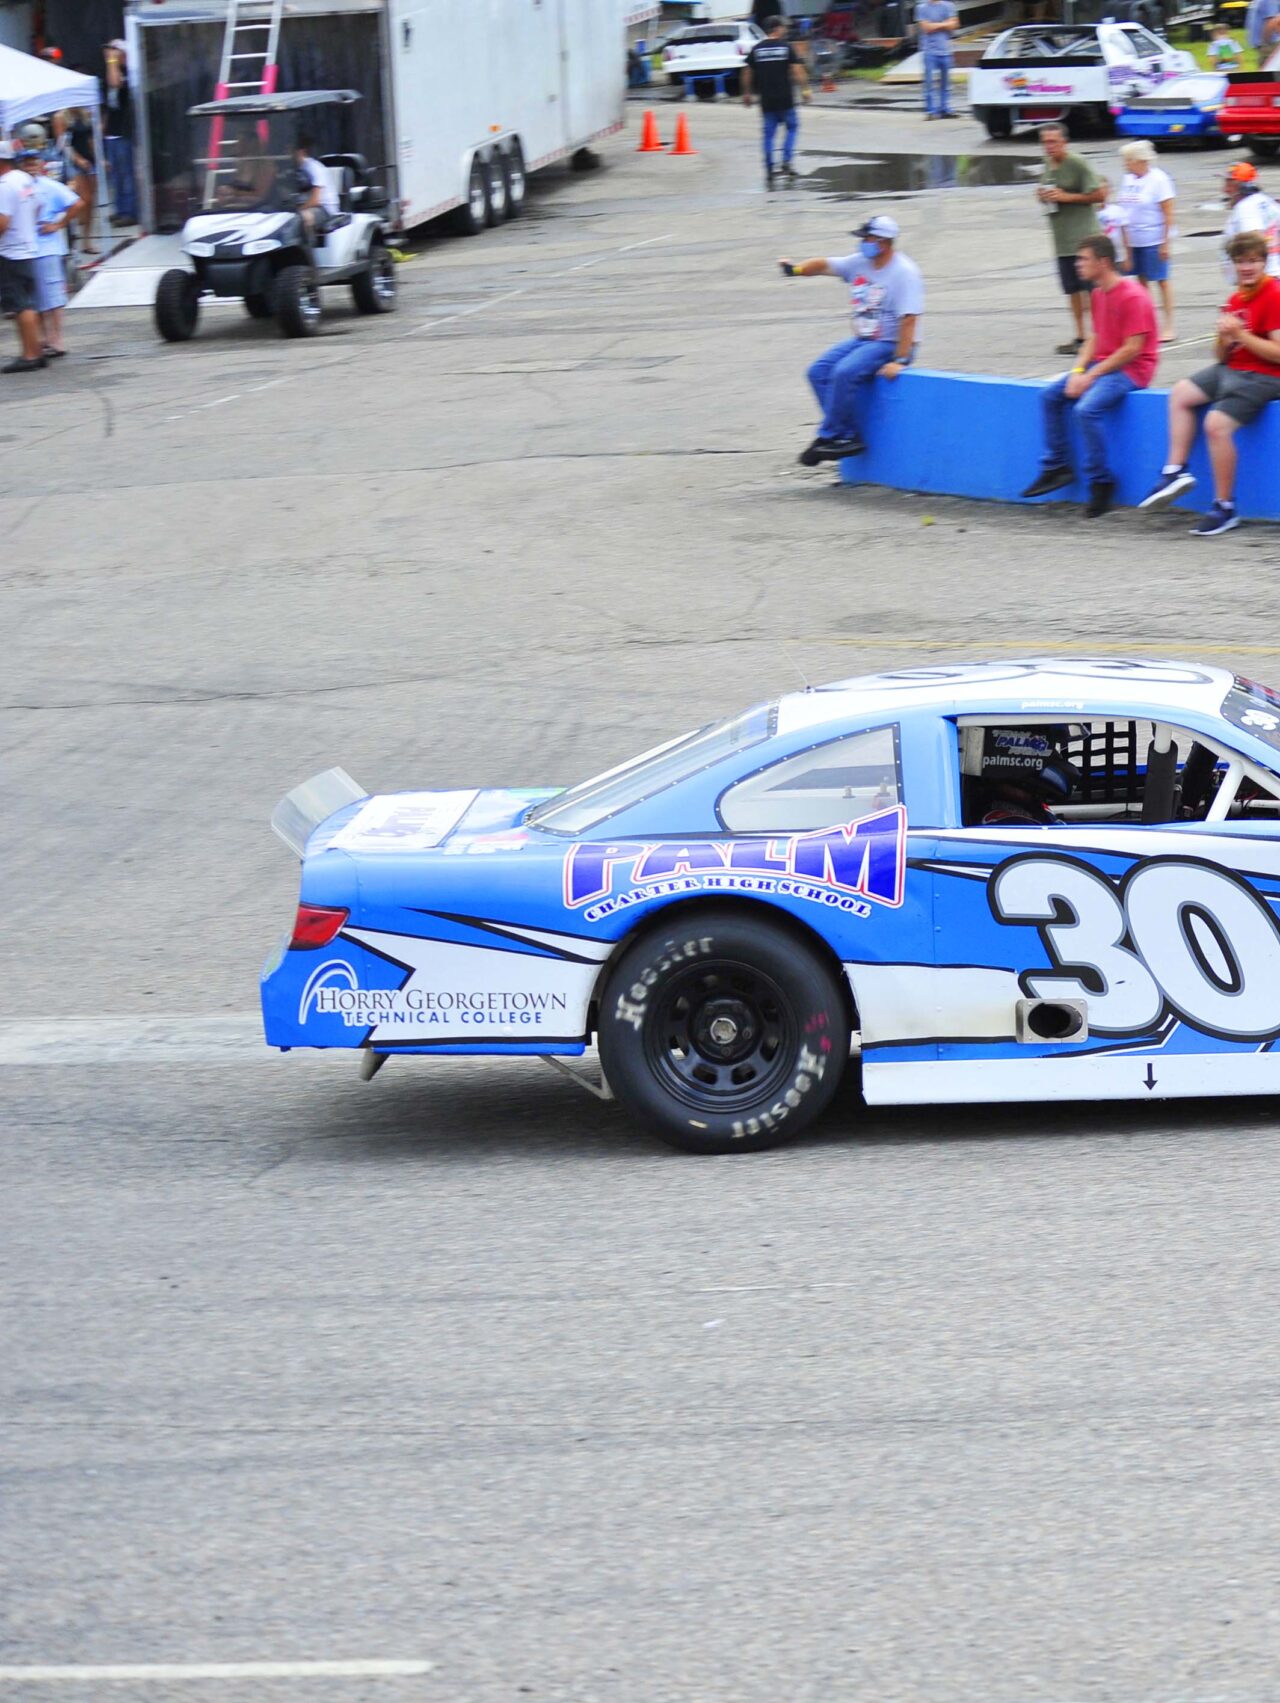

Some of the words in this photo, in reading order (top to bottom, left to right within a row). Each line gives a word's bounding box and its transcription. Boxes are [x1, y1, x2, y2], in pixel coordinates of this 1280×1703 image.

[983, 755, 1043, 770] palmsc.org
[563, 805, 908, 909] PALM
[585, 878, 700, 921] CHARTER
[703, 877, 775, 892] HIGH
[780, 879, 872, 917] SCHOOL
[319, 989, 398, 1010] HORRY
[406, 989, 567, 1010] GEORGETOWN
[345, 1011, 450, 1024] TECHNICAL
[460, 1010, 543, 1024] COLLEGE
[731, 1043, 827, 1138] Hoosier
